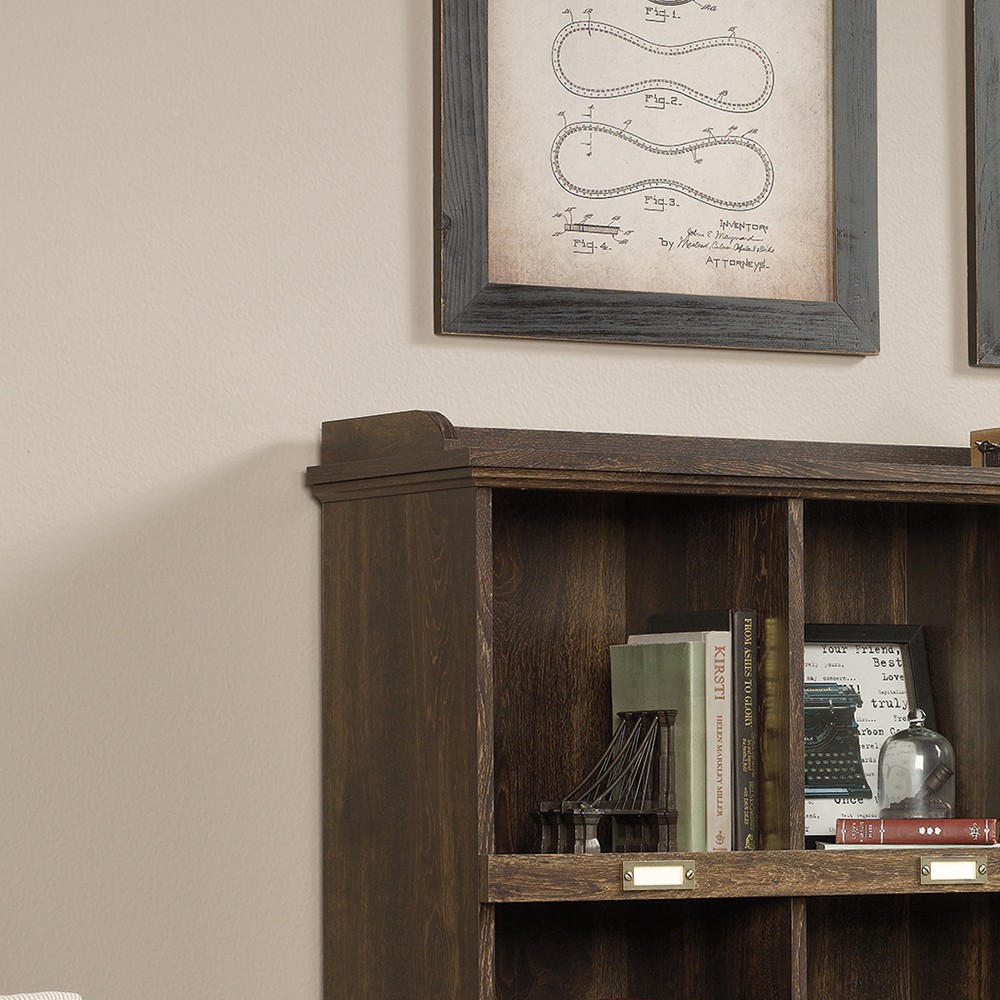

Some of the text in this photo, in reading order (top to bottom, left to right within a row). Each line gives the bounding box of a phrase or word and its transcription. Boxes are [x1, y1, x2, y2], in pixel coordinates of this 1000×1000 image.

[821, 645, 848, 655] Your
[872, 657, 903, 668] Best
[714, 645, 726, 701] KIRSTI
[744, 618, 753, 728] FROM ASHES TO GLORY
[881, 672, 905, 682] Love
[870, 698, 908, 710] truly
